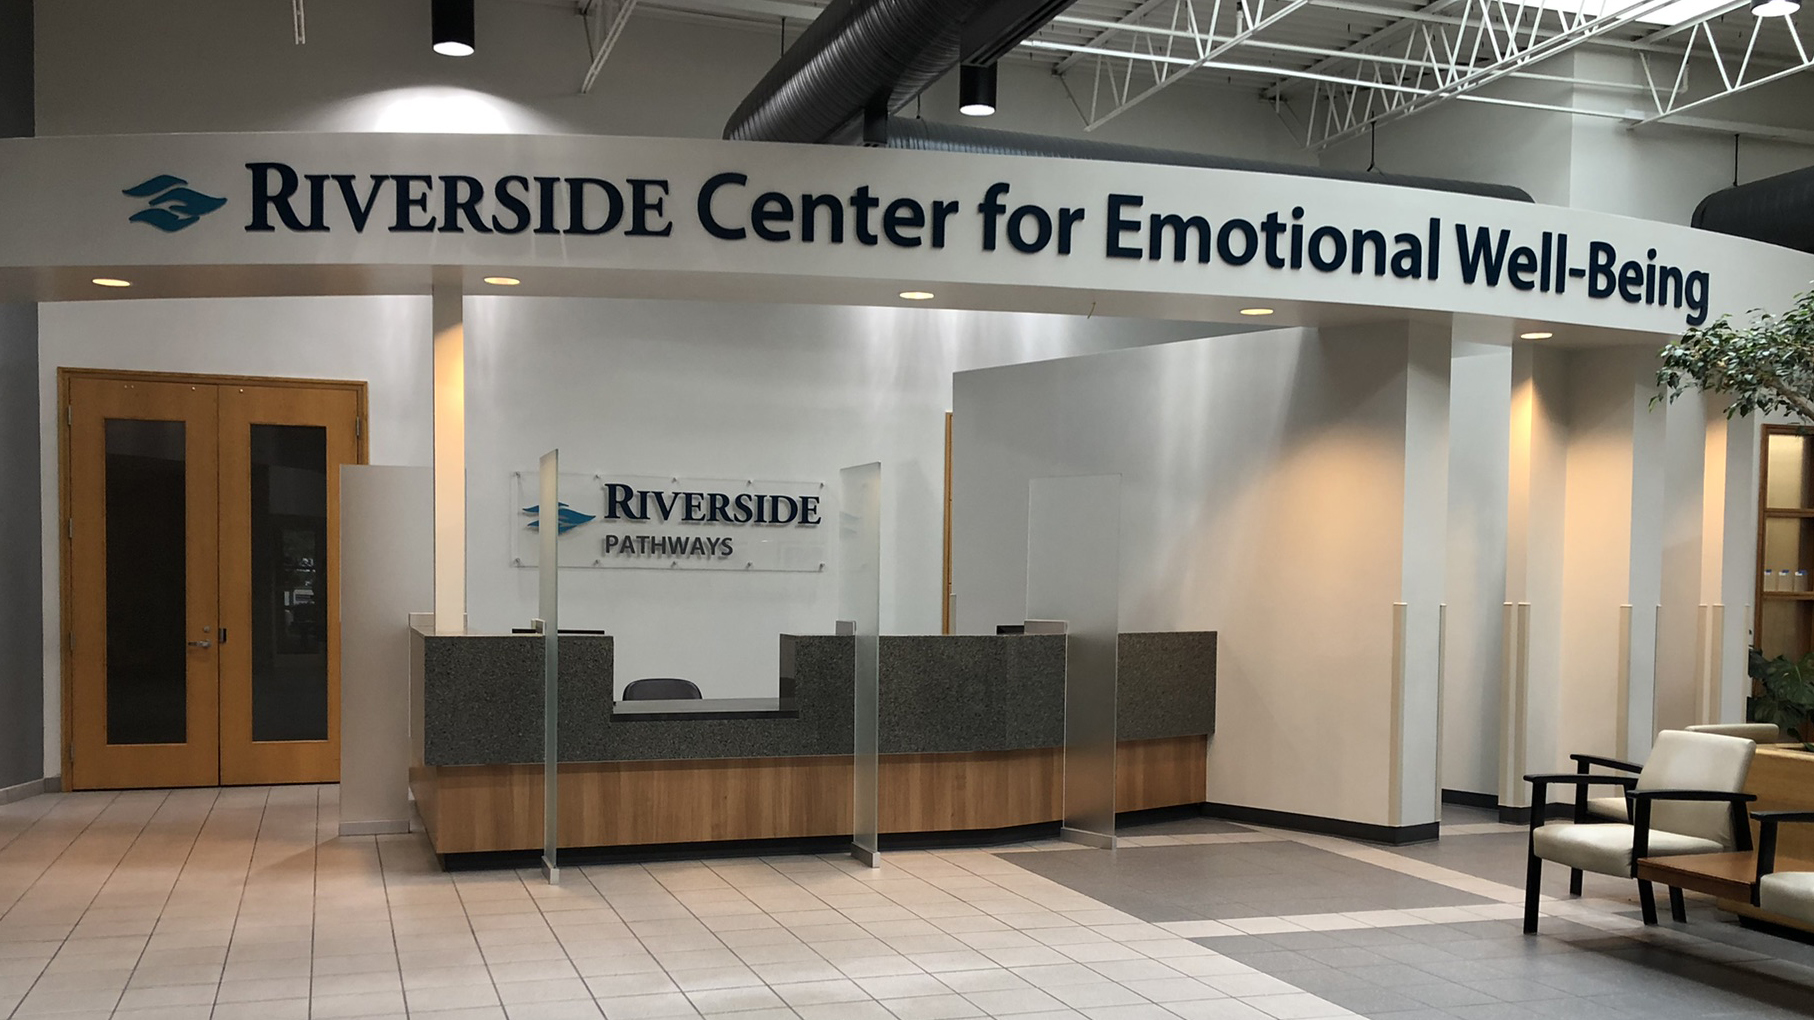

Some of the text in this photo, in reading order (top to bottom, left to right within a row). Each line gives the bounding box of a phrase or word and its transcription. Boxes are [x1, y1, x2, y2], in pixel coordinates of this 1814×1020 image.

[244, 162, 1710, 327] RIVERSIDE Center for Emotional Well-Being
[604, 483, 822, 526] RIVERSIDE
[605, 534, 733, 557] PATHWAYS
